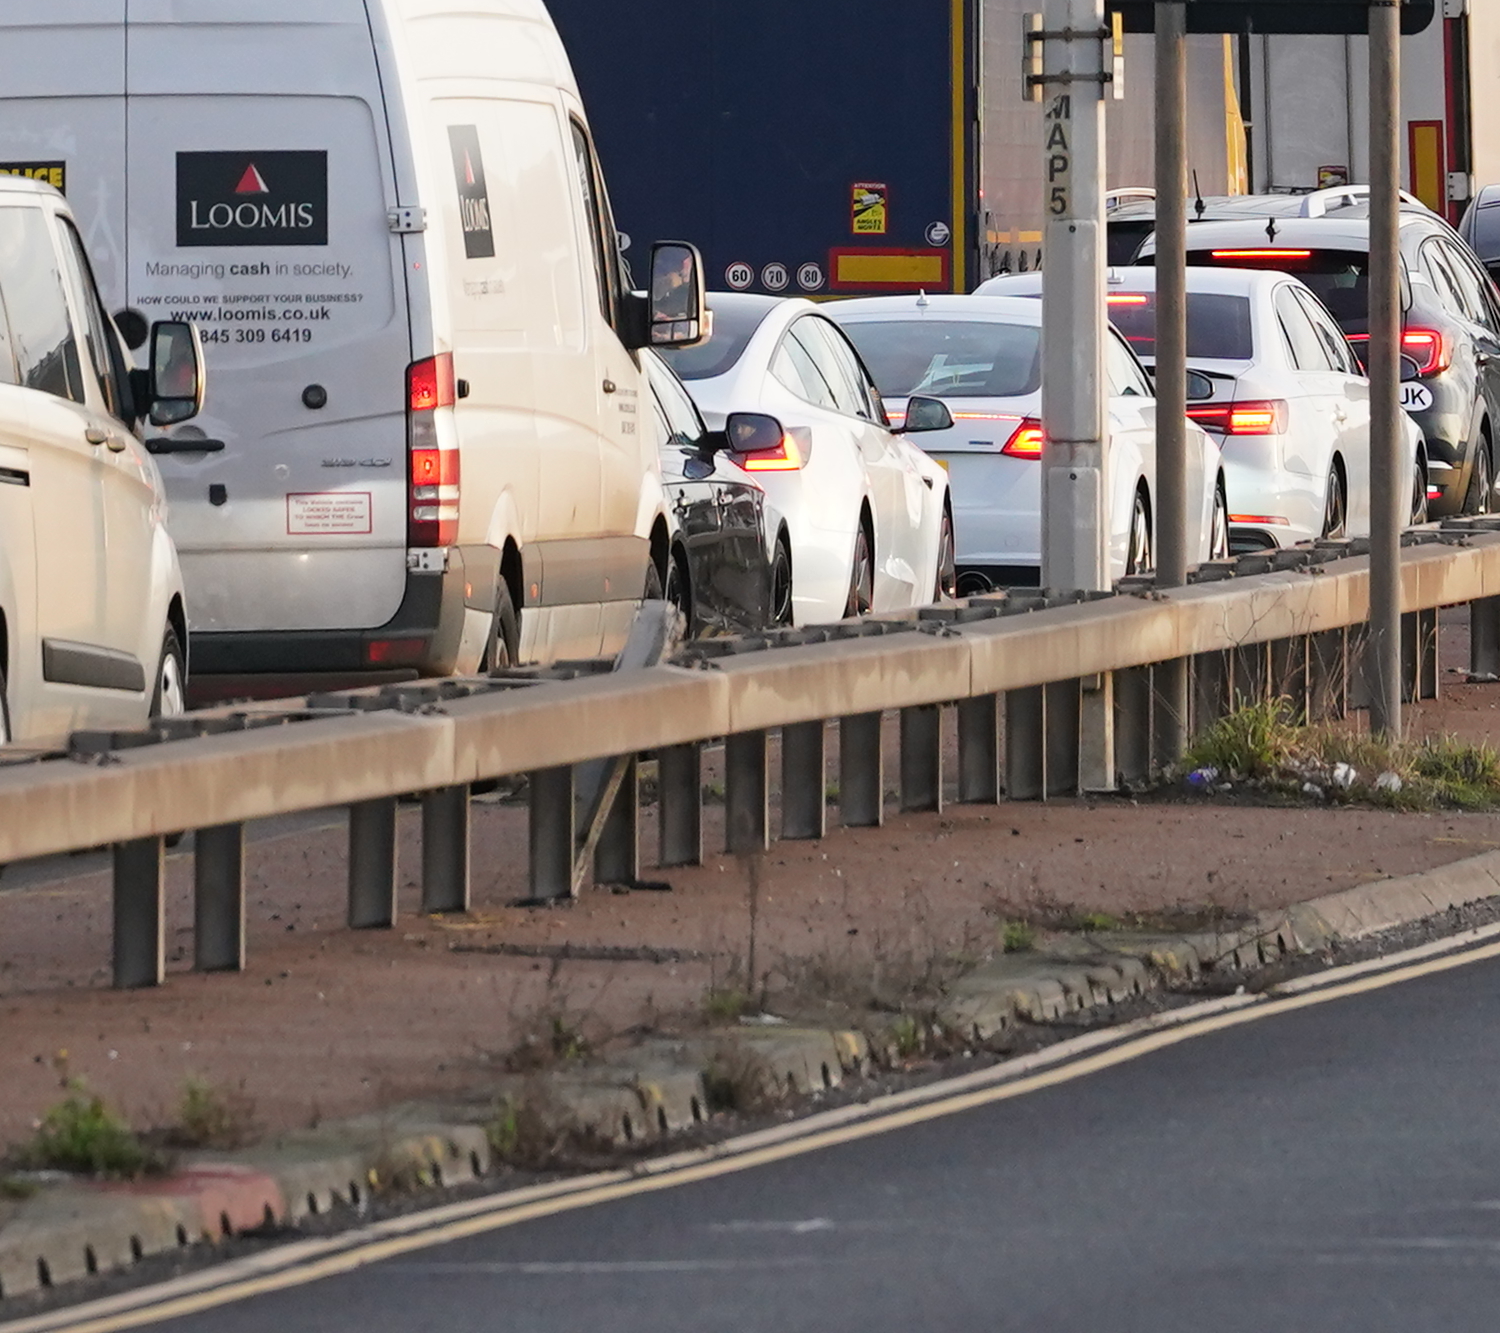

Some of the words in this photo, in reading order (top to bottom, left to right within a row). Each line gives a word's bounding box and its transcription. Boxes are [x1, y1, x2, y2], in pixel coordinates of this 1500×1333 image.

[190, 200, 313, 228] LOOMIS
[145, 262, 225, 279] Managing
[230, 262, 270, 275] cash
[276, 262, 289, 275] in
[293, 262, 353, 279] society.
[732, 270, 747, 282] 60
[768, 270, 783, 283] 70
[804, 270, 818, 283] 80
[137, 296, 162, 305] HOW
[164, 295, 200, 305] COULD
[203, 295, 218, 304] WE
[222, 294, 270, 304] SUPPORT
[273, 294, 302, 303] YOUR
[305, 293, 363, 303] BUSINESS?
[171, 307, 331, 322] www.loomis.co.uk
[236, 329, 265, 343] 309
[272, 328, 312, 343] 6419
